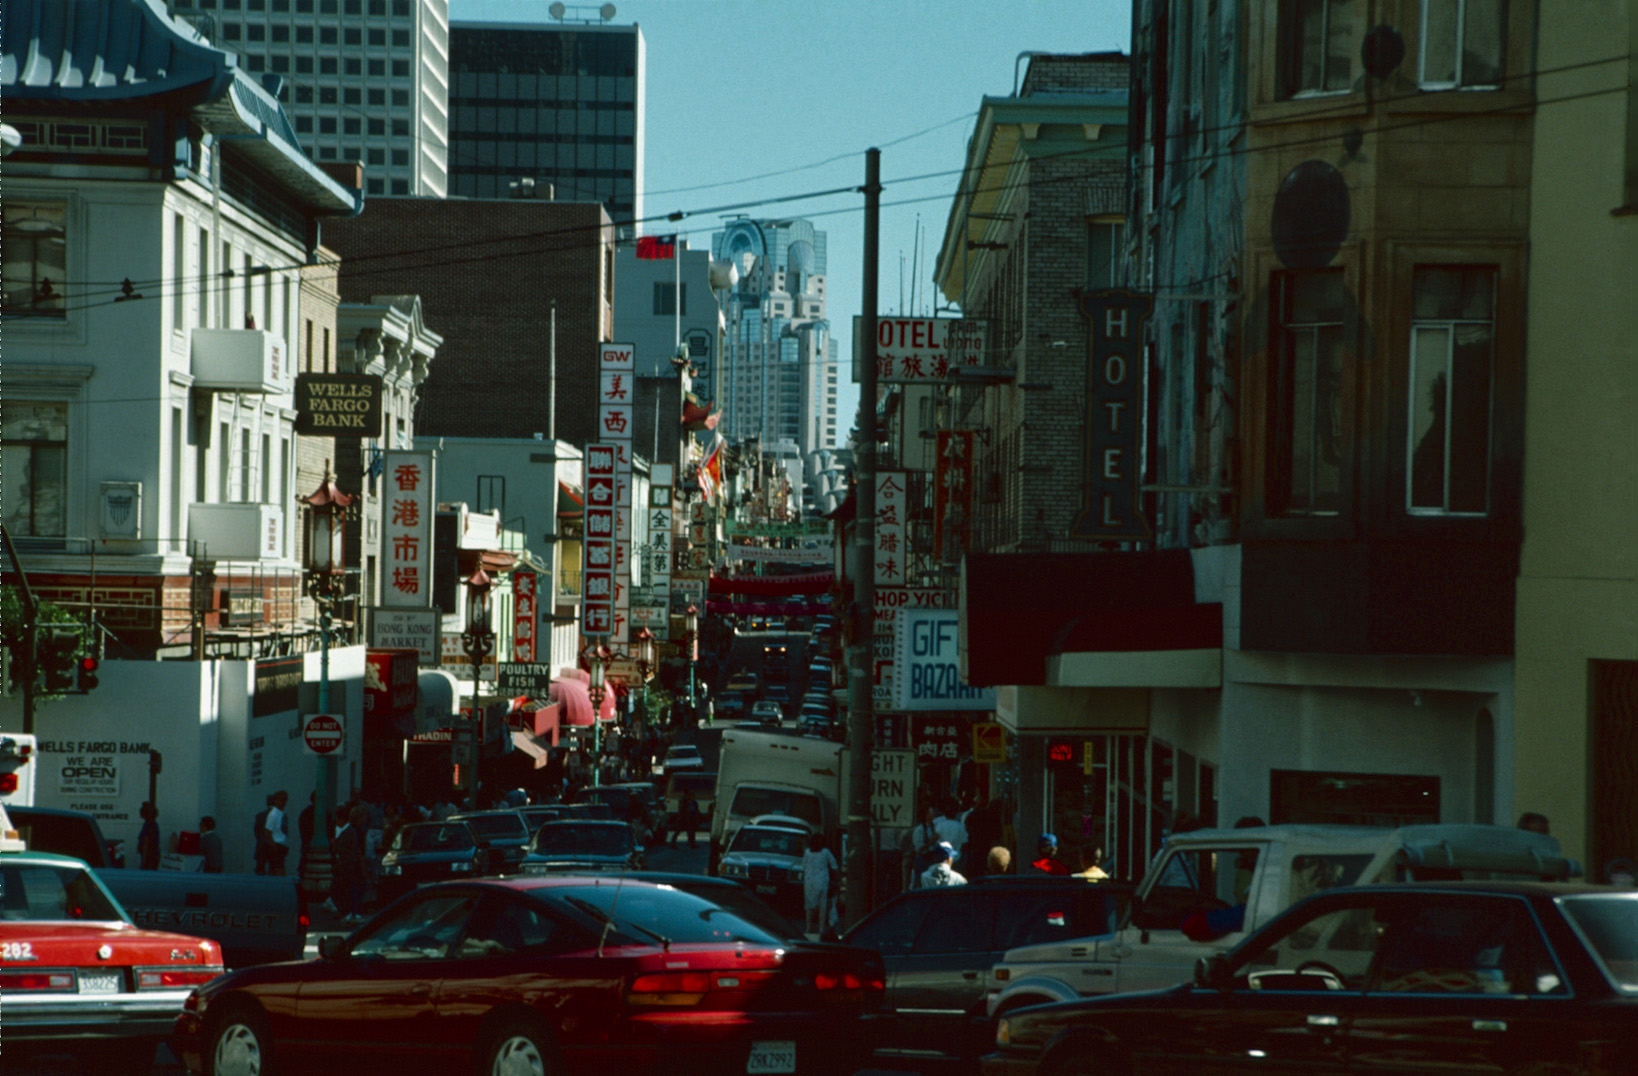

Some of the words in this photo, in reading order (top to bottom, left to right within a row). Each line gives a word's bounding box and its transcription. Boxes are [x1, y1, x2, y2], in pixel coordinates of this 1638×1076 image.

[879, 321, 940, 348] OTEL
[603, 351, 631, 362] GW
[307, 383, 373, 397] WELLS
[309, 399, 370, 412] FARGO
[313, 414, 366, 428] BANK
[1105, 308, 1127, 525] HOTEL
[392, 464, 421, 595] 香港市場
[875, 592, 909, 606] HOP
[377, 623, 403, 634] HONG
[407, 624, 432, 634] KONG
[381, 637, 427, 648] MARKET
[499, 664, 548, 675] POULTRY
[508, 676, 535, 687] FISH
[310, 722, 320, 730] DO
[323, 721, 337, 730] NOT
[413, 731, 452, 741] TRADIN
[38, 742, 74, 753] WELLS
[78, 742, 116, 753] FARGO
[120, 742, 151, 753] BANK
[311, 740, 336, 748] ENTER
[918, 740, 958, 759] 肉店
[66, 757, 85, 766] WE
[90, 757, 113, 766] ARE
[871, 755, 905, 773] GHT
[62, 767, 116, 778] OPEN
[871, 780, 904, 798] RN
[871, 804, 903, 822] LY
